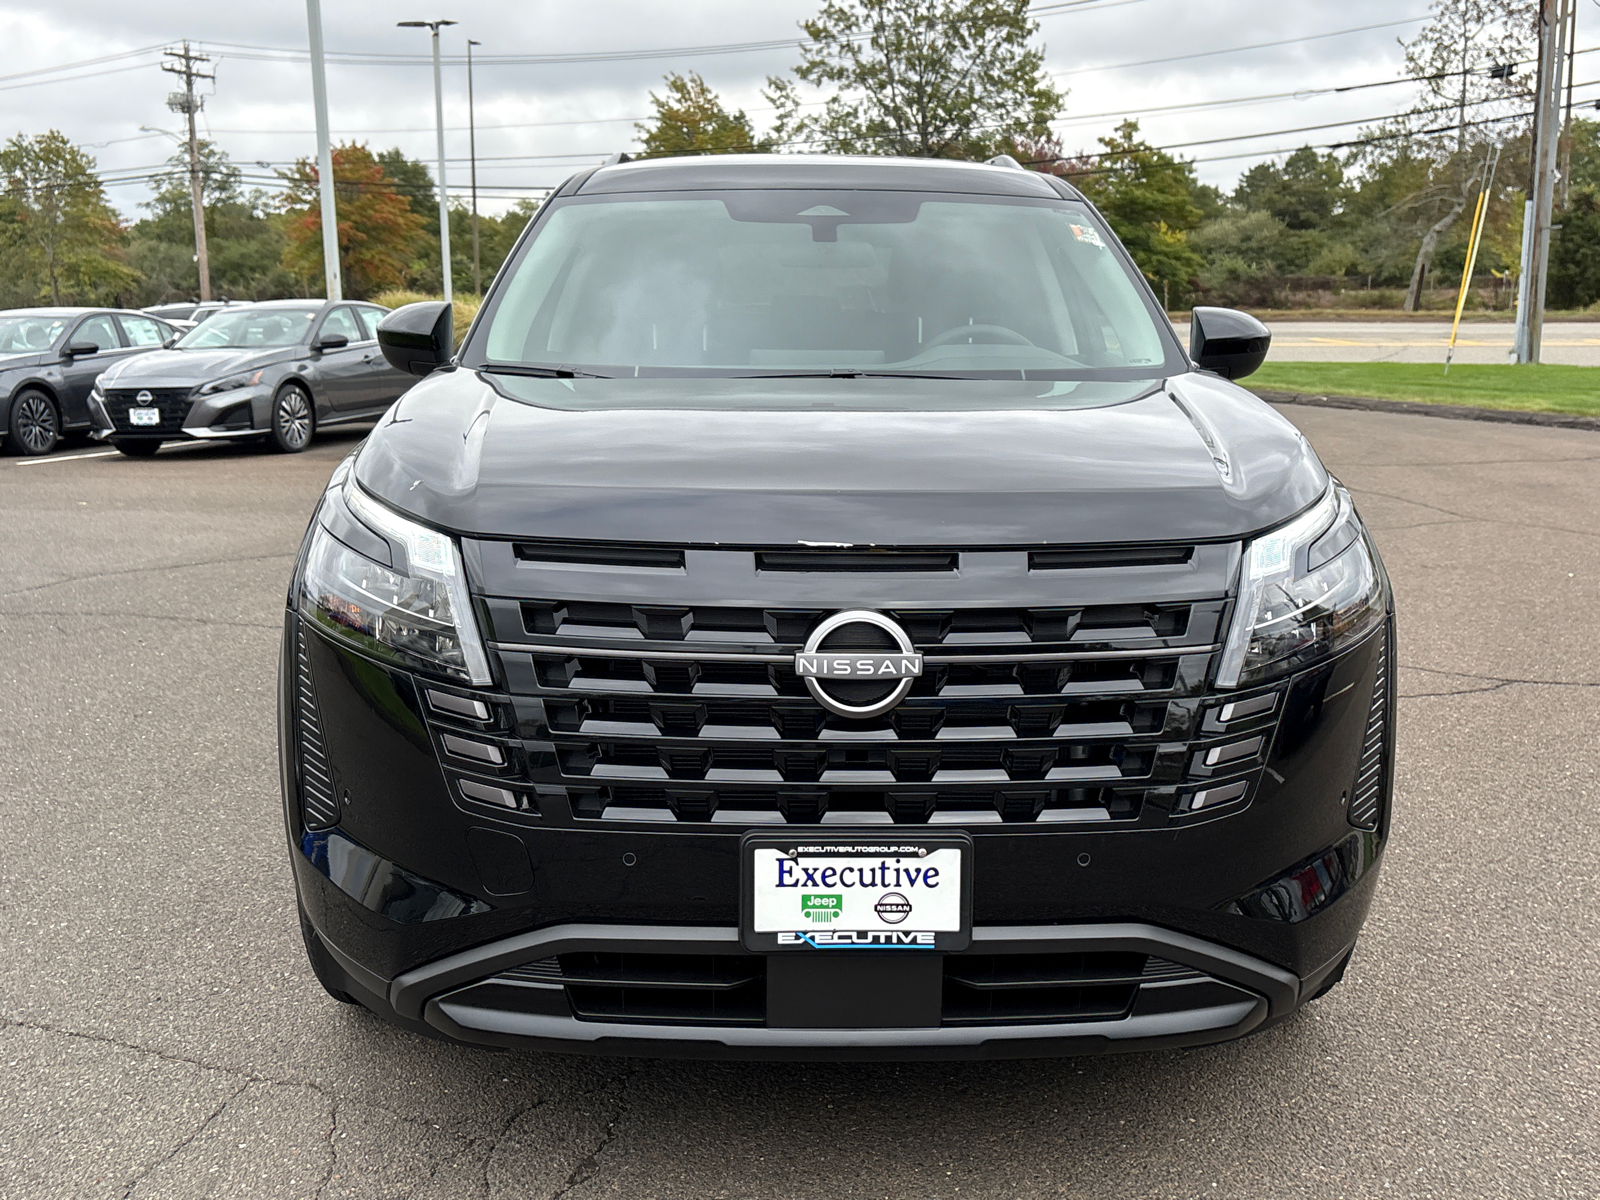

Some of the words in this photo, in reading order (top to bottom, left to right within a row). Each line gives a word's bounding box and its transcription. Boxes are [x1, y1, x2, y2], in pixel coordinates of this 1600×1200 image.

[799, 658, 919, 674] NISSAN
[775, 858, 940, 888] Executive
[807, 895, 837, 908] Jeep
[777, 932, 935, 946] EXECUTIVE
